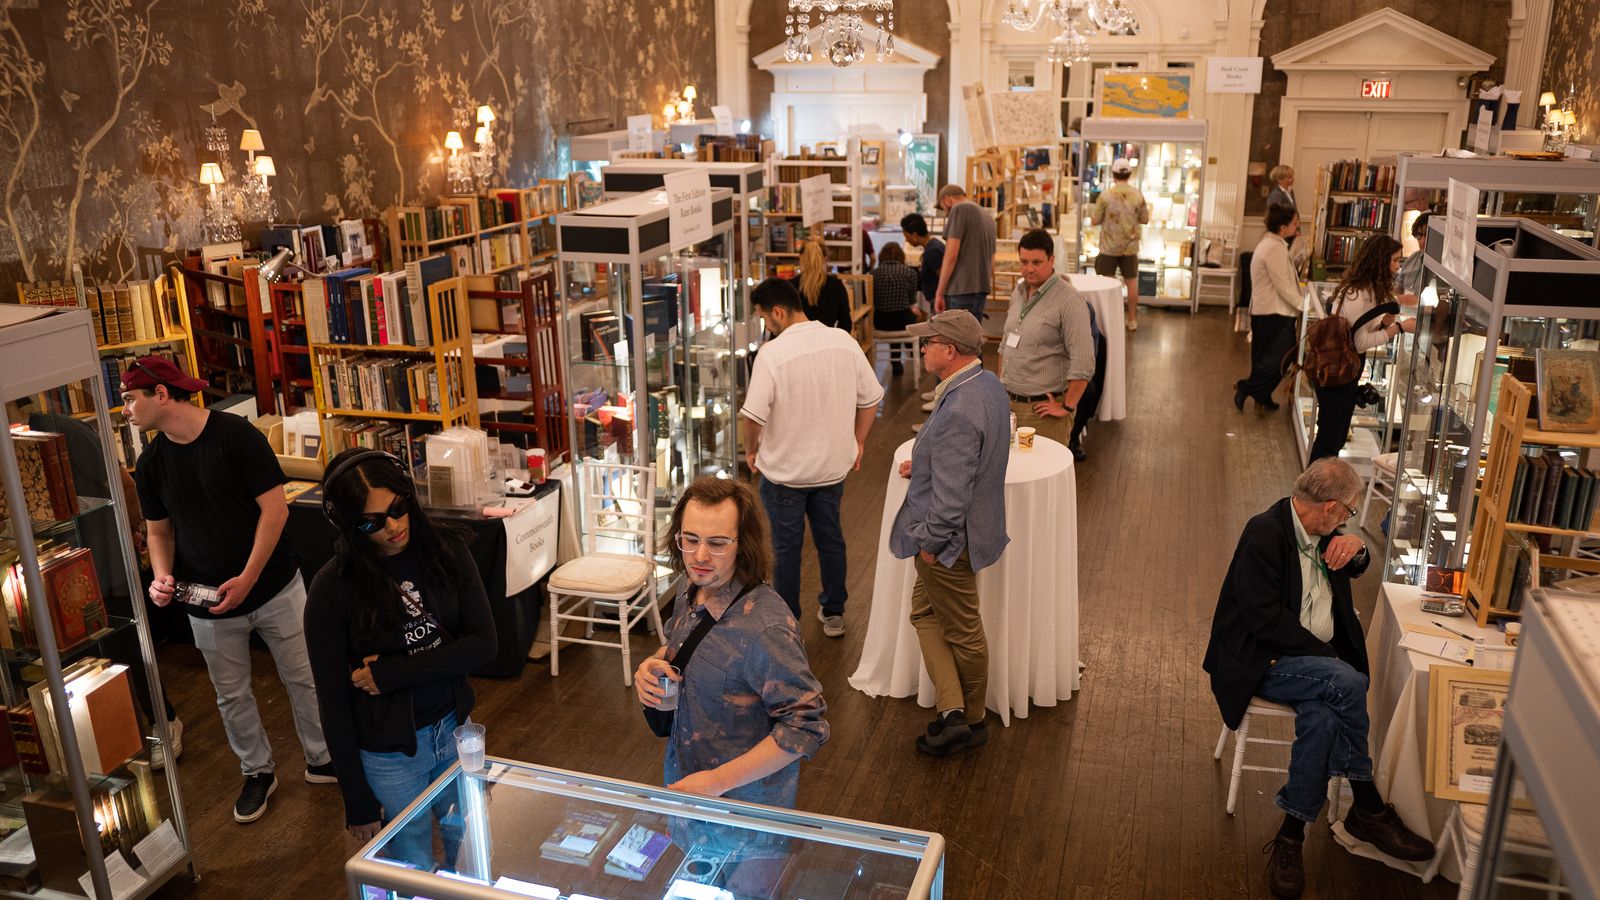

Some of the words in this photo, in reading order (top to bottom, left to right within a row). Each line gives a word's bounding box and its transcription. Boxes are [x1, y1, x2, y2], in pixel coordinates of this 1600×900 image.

[1362, 81, 1390, 98] EXIT
[690, 204, 703, 216] Books
[515, 513, 554, 545] Commonwealth
[529, 537, 545, 553] Books
